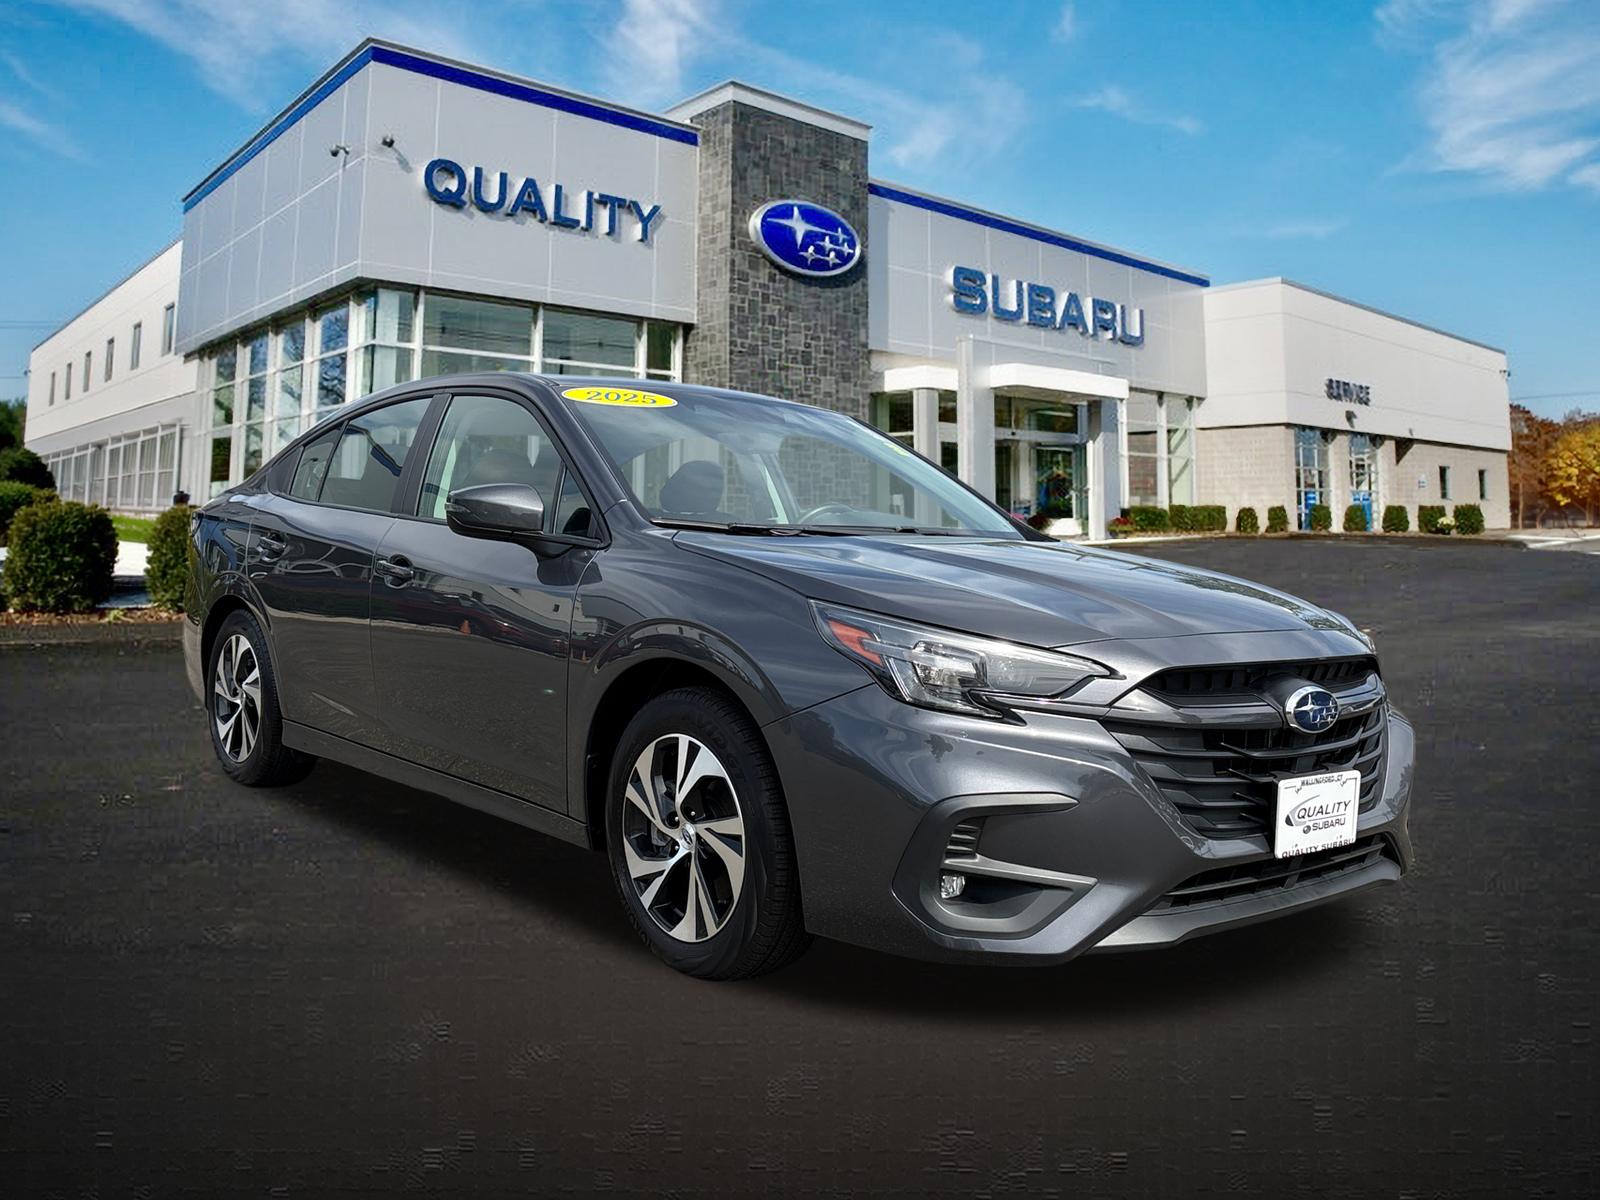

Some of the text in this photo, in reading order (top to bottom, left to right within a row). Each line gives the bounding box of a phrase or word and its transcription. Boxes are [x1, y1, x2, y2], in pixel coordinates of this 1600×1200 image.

[424, 158, 662, 242] QUALITY
[946, 265, 1144, 346] SUBARU
[585, 390, 658, 405] 2025
[1325, 377, 1371, 406] SERVICE
[1297, 799, 1352, 820] QUALITY
[1312, 817, 1346, 831] SUBARU
[1281, 837, 1355, 858] QUALITY SUBARU
